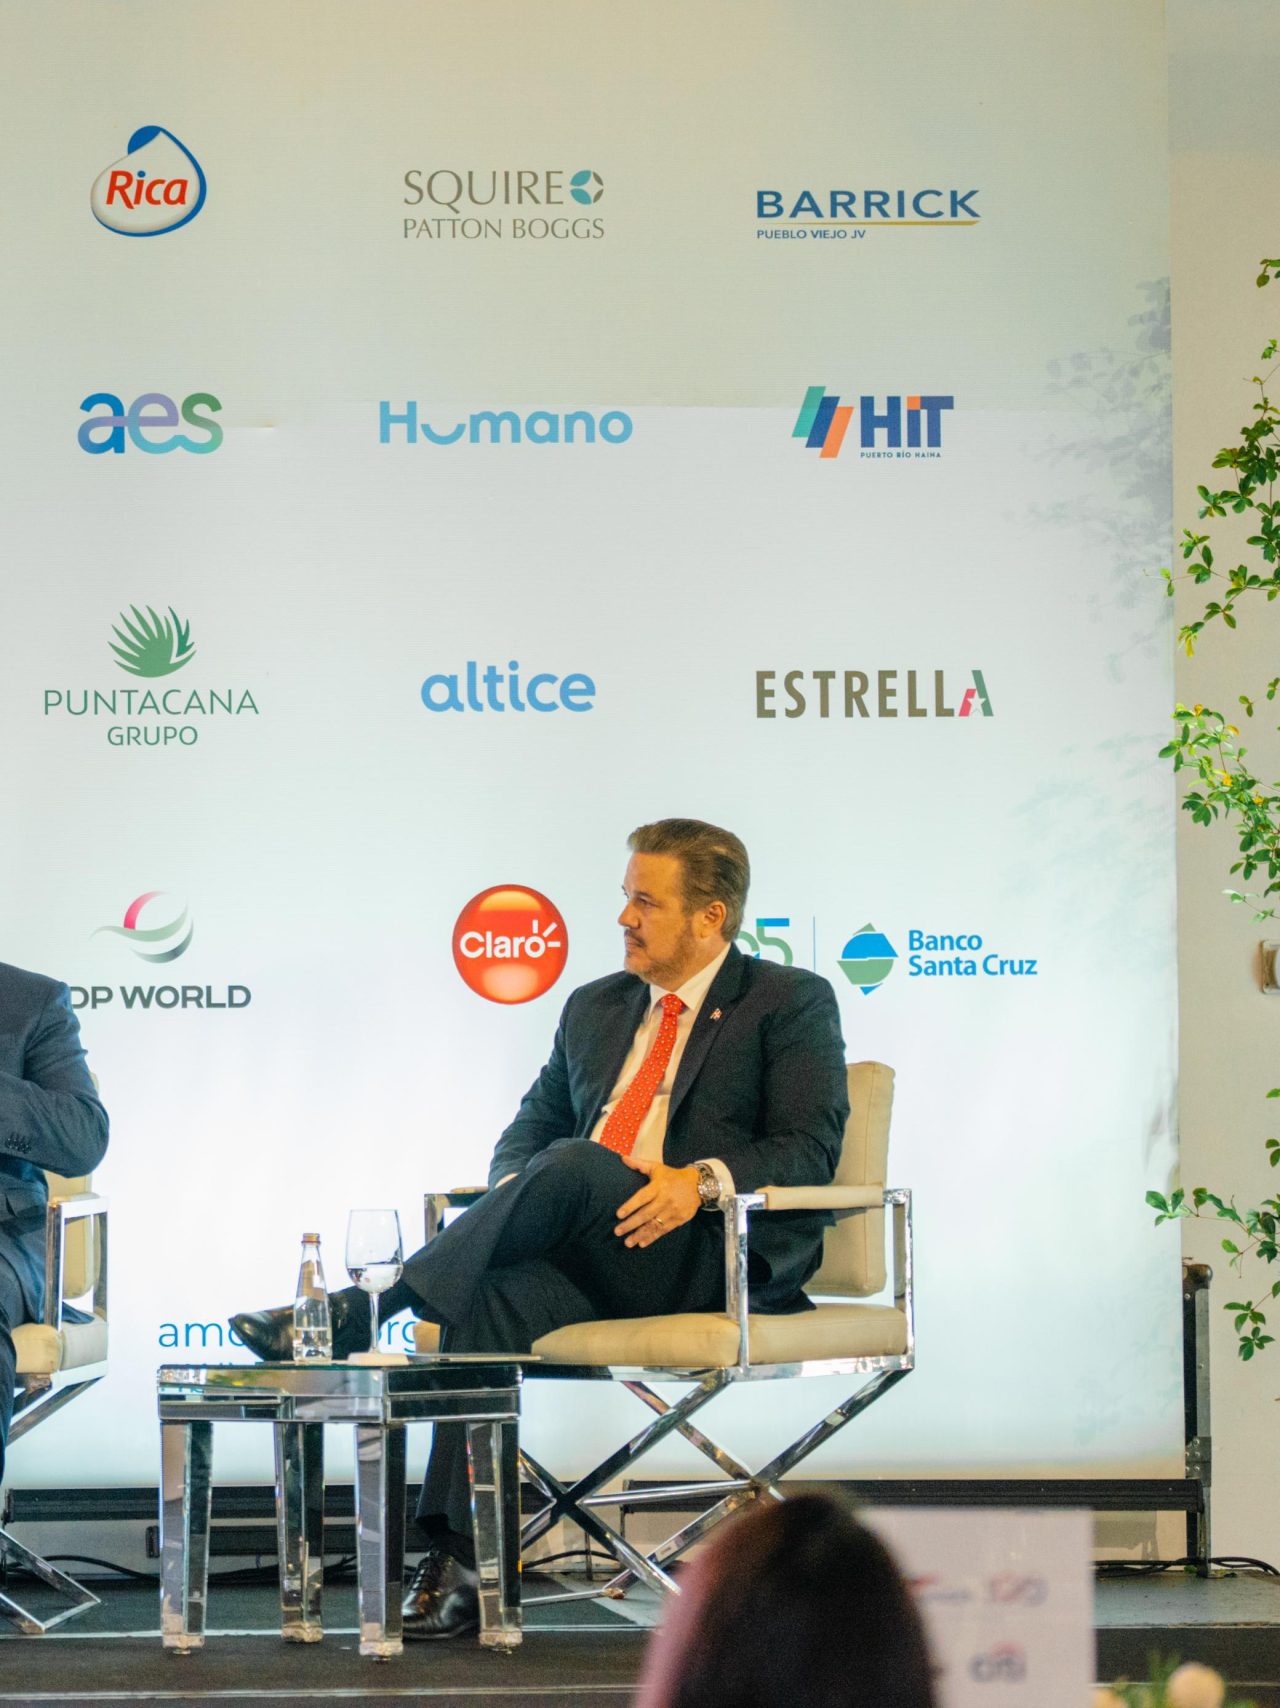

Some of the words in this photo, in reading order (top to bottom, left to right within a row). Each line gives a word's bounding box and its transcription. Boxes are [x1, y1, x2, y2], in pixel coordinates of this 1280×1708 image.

[105, 169, 189, 210] Rica
[403, 169, 564, 214] SQUIRE
[756, 189, 981, 218] BARRICK
[403, 217, 502, 239] PATTON
[512, 217, 605, 239] BOGGS
[756, 229, 807, 239] PUEBLO
[810, 229, 847, 239] VIEJO
[851, 229, 866, 239] JV
[77, 392, 223, 455] aes
[379, 400, 634, 446] Humano
[420, 659, 596, 713] altice
[755, 669, 994, 718] ESTRELLA
[44, 688, 260, 716] PUNTACANA
[107, 725, 199, 746] GRUPO
[459, 929, 546, 960] Claro
[908, 929, 983, 951] Banco
[908, 954, 977, 976] Santa
[982, 953, 1038, 976] Cruz
[70, 985, 114, 1010] DP
[119, 984, 252, 1010] WORLD
